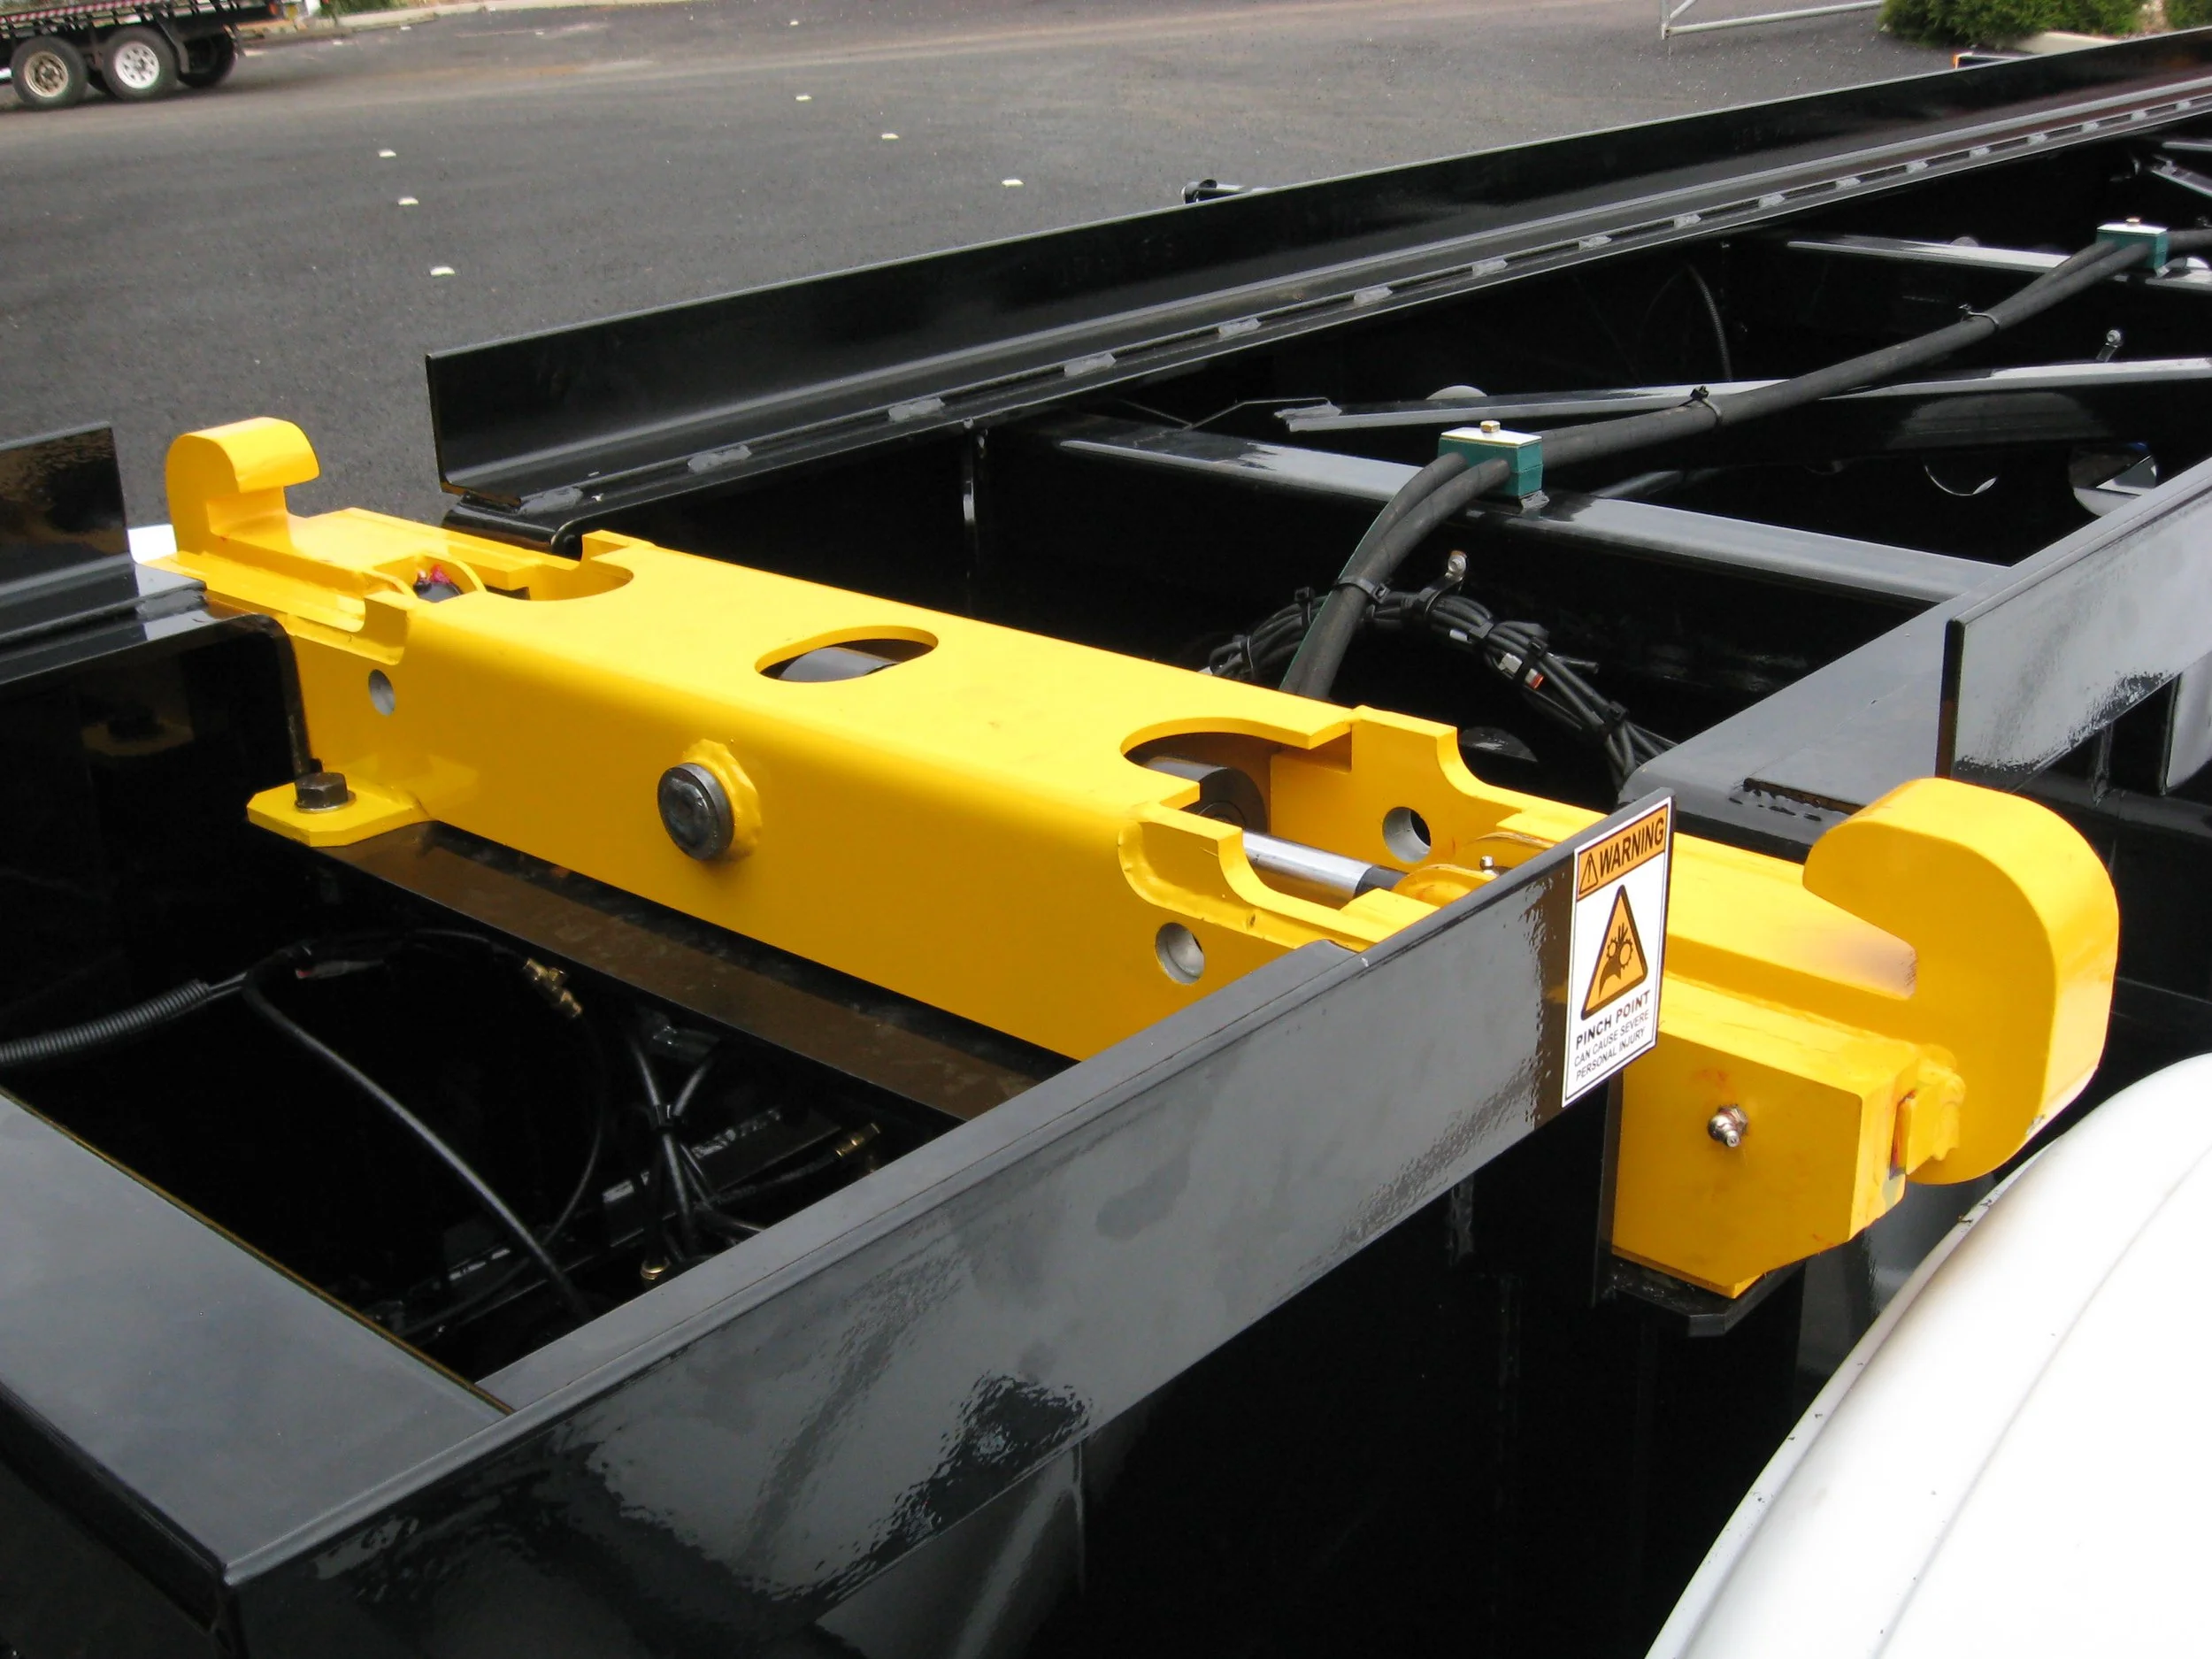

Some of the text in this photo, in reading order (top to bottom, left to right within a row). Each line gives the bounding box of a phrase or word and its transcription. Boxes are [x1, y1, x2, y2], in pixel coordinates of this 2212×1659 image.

[1599, 817, 1664, 879] WARNING
[1574, 1010, 1649, 1067] CAN CAUSE SEVERE
[1576, 990, 1651, 1050] PINCH POINT
[1576, 1026, 1646, 1081] PERSONAL INJURY
